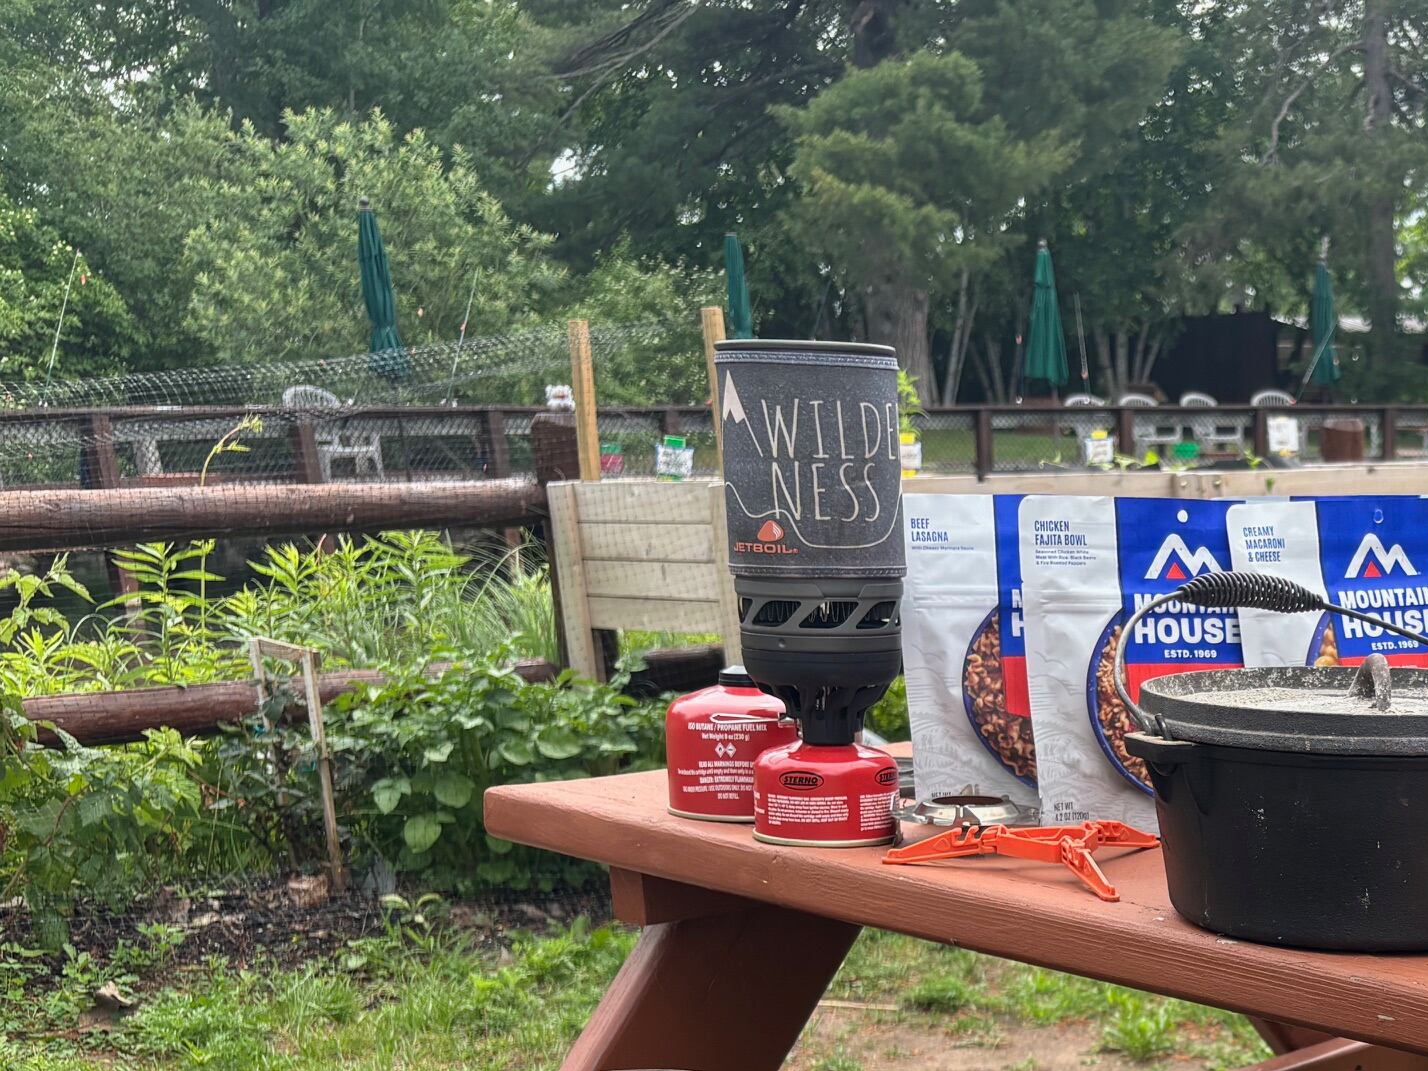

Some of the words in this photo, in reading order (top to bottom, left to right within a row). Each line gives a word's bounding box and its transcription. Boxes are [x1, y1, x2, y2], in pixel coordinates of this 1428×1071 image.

[761, 398, 899, 460] WILDE
[772, 461, 880, 522] NESS
[910, 518, 930, 529] BEEF
[1034, 520, 1070, 532] CHICKEN
[911, 531, 949, 542] LASAGNA
[1242, 525, 1274, 537] CREAMY
[1035, 534, 1062, 546] FAJITA
[1064, 534, 1087, 546] BOWL
[1245, 537, 1285, 550] MACARONI
[1248, 551, 1254, 562] &
[1255, 551, 1281, 562] CHEESE
[1134, 617, 1242, 644] HOUSE
[1371, 641, 1397, 651] ESTD.
[1398, 640, 1419, 649] 1969
[1164, 649, 1192, 658] ESTD.
[1194, 649, 1218, 658] 1969
[717, 723, 742, 732] PROPANE
[783, 775, 819, 785] STERNO
[1053, 802, 1063, 811] NET
[1064, 801, 1073, 810] WT
